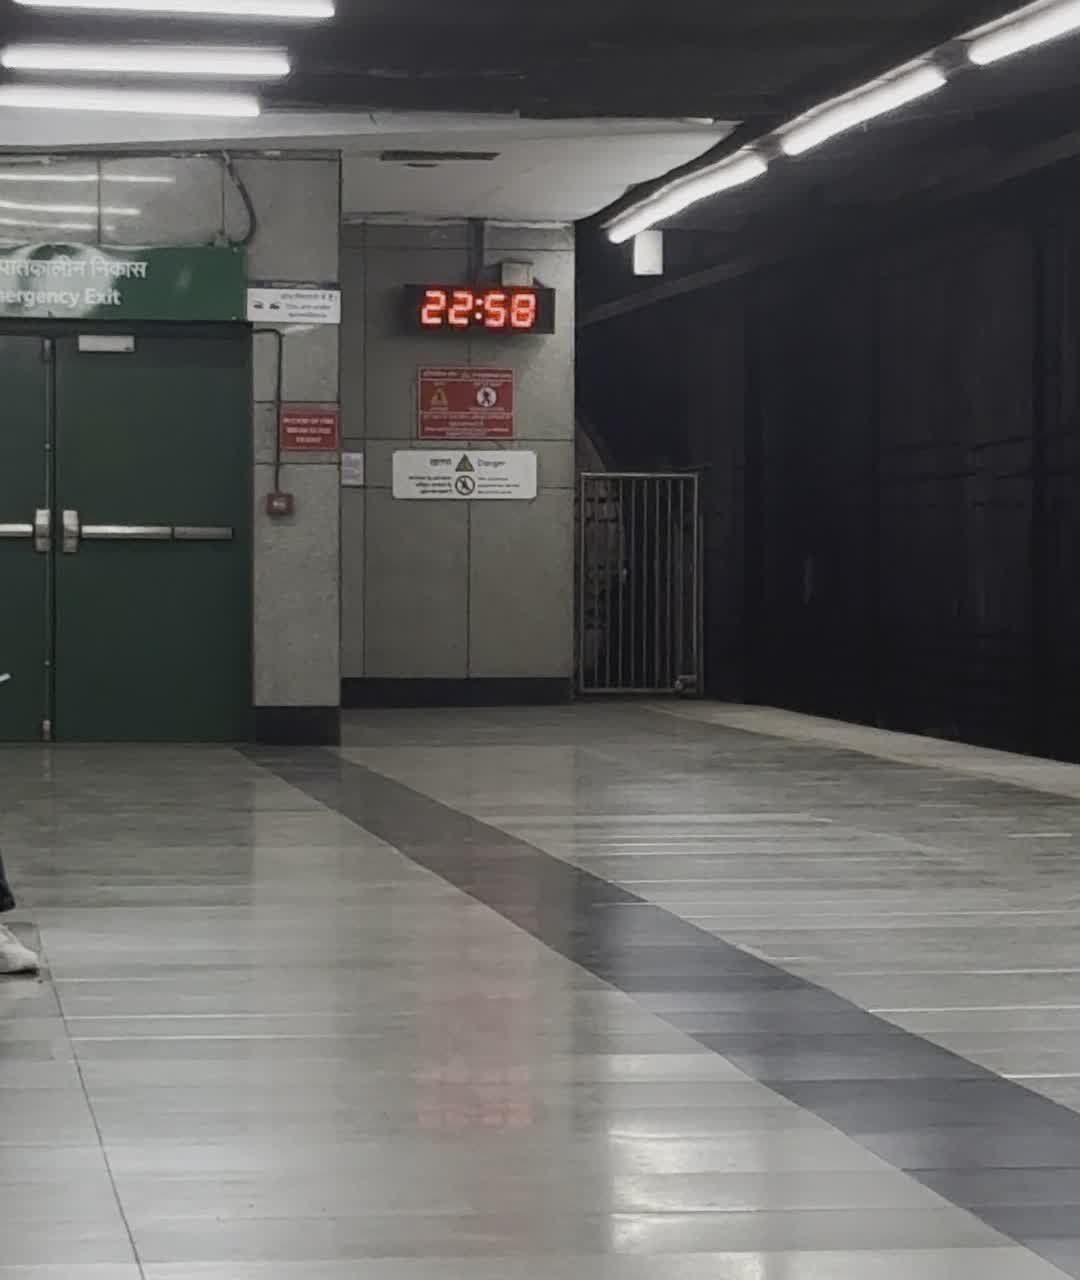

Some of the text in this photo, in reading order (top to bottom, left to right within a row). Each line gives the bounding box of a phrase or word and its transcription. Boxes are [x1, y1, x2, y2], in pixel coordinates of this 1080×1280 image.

[91, 256, 148, 278] निकास
[85, 288, 121, 305] Exit
[421, 291, 536, 328] 22:58
